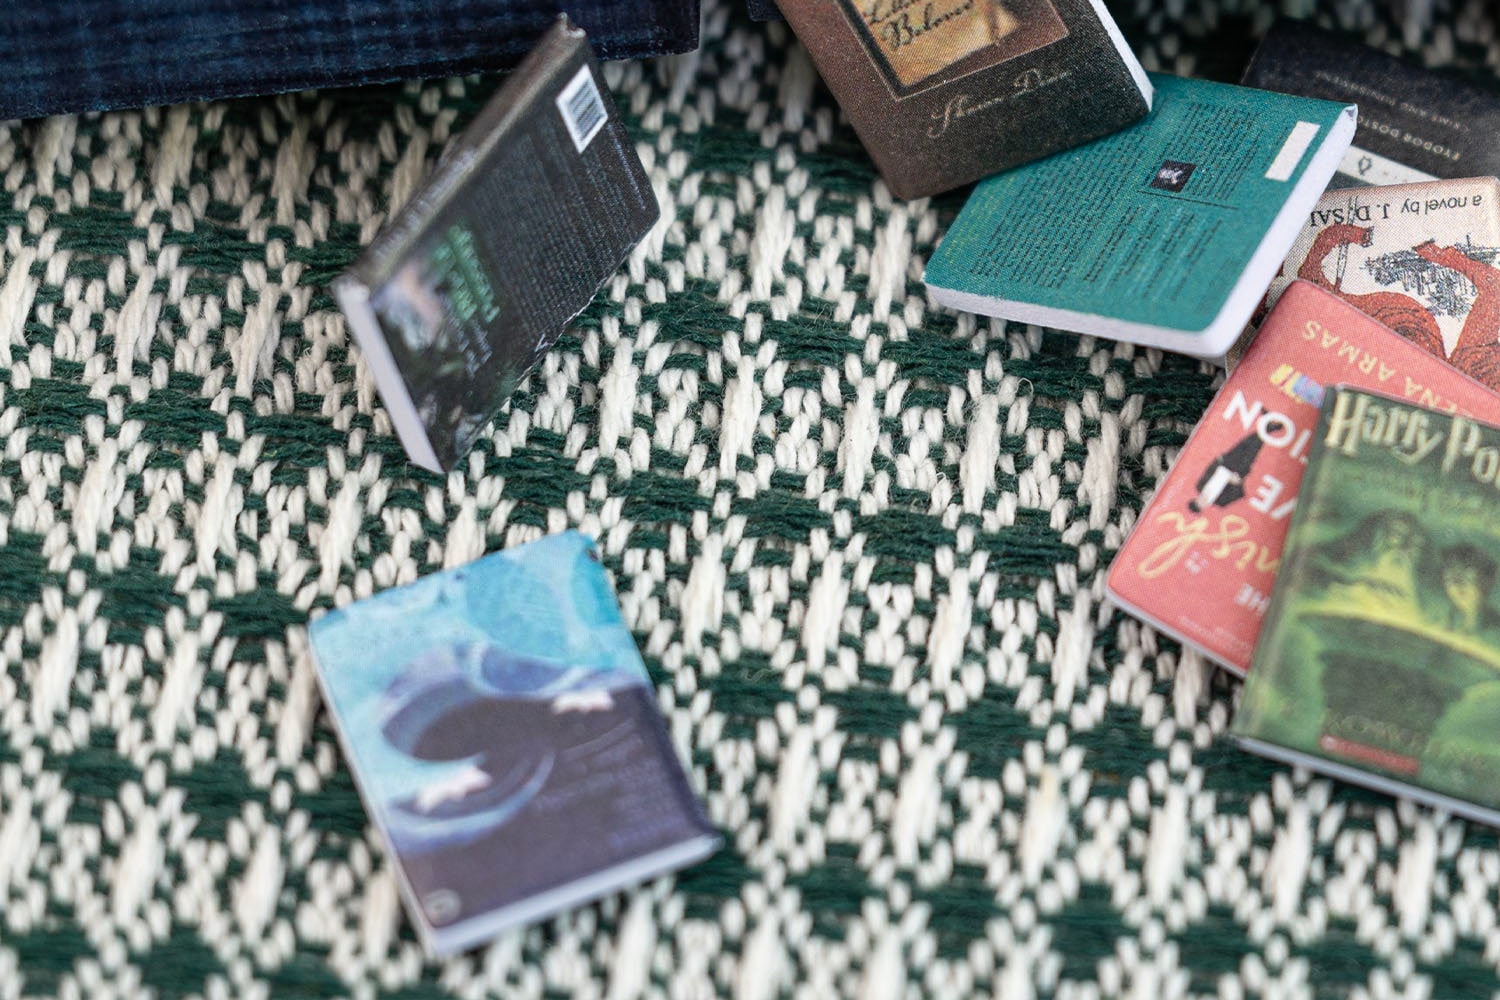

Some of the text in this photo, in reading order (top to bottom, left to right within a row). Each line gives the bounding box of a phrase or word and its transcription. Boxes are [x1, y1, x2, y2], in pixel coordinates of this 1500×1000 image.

[1400, 198, 1420, 215] by
[1428, 196, 1468, 210] novel
[1473, 195, 1483, 207] a
[1377, 204, 1390, 219] J.
[1298, 317, 1395, 384] ARMAS
[1223, 391, 1310, 463] ION
[1325, 391, 1447, 461] Harry
